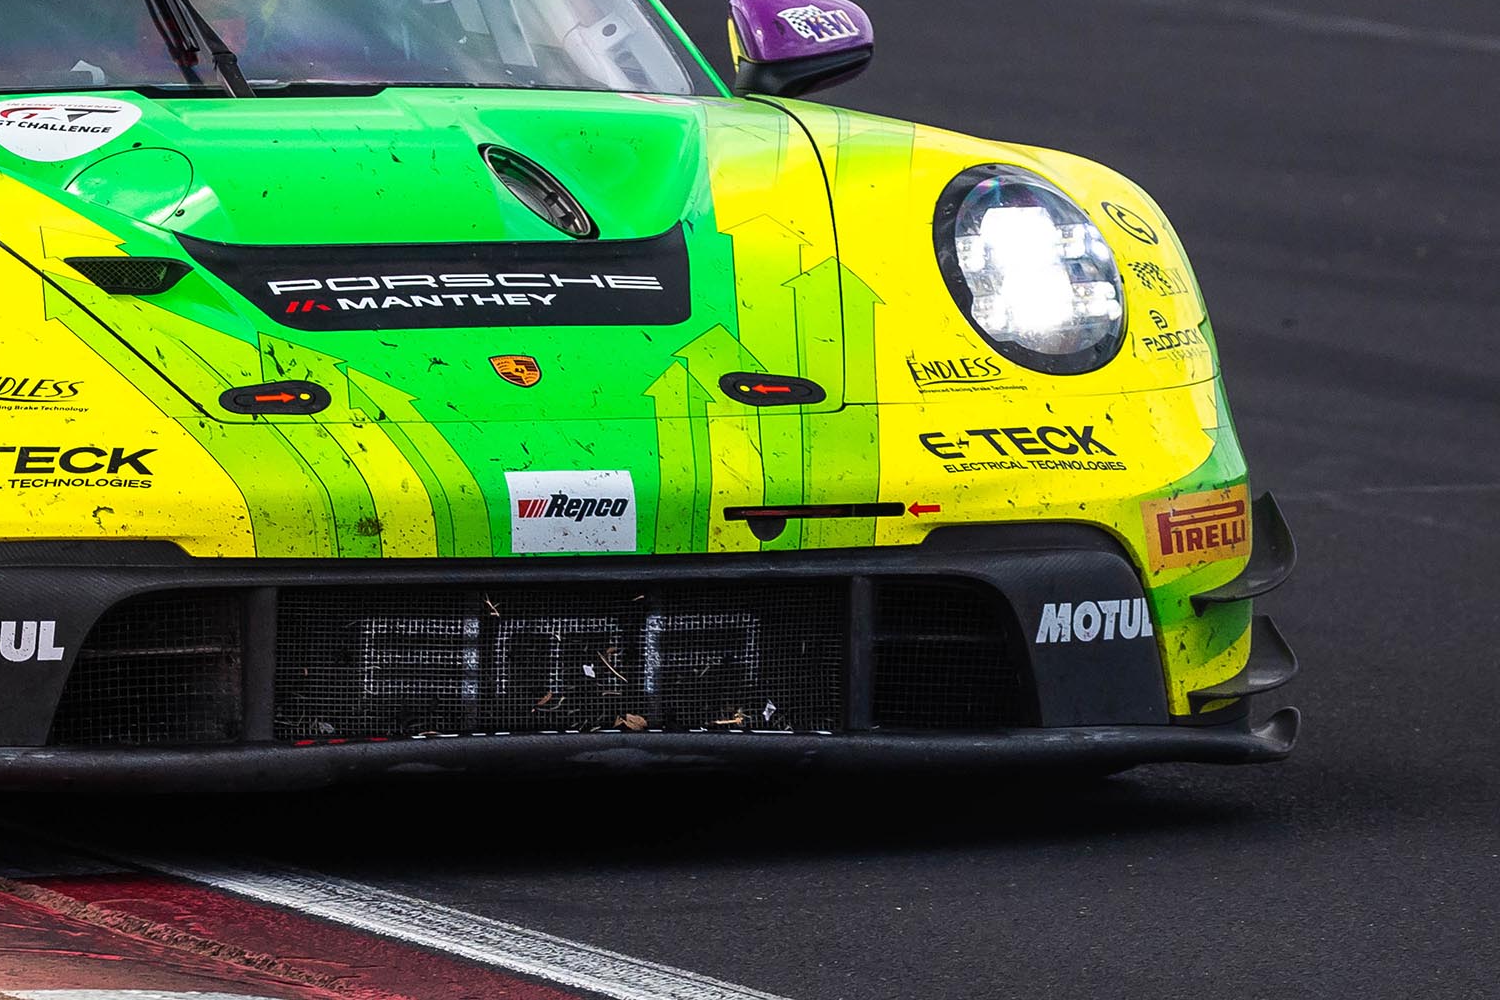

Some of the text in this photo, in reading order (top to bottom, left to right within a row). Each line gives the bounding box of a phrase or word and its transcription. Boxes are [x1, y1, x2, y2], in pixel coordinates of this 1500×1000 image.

[17, 121, 112, 134] CHALLENGE
[267, 272, 664, 296] PORSCHE
[337, 293, 557, 311] MANTHEY
[907, 356, 1002, 382] ENDLESS
[41, 405, 90, 413] Technology
[943, 459, 1127, 474] ELECTRICAL TECHNOLOGIES
[7, 478, 152, 489] TECHNOLOGIES
[544, 493, 629, 522] Repco
[1156, 500, 1246, 556] PIRELLI
